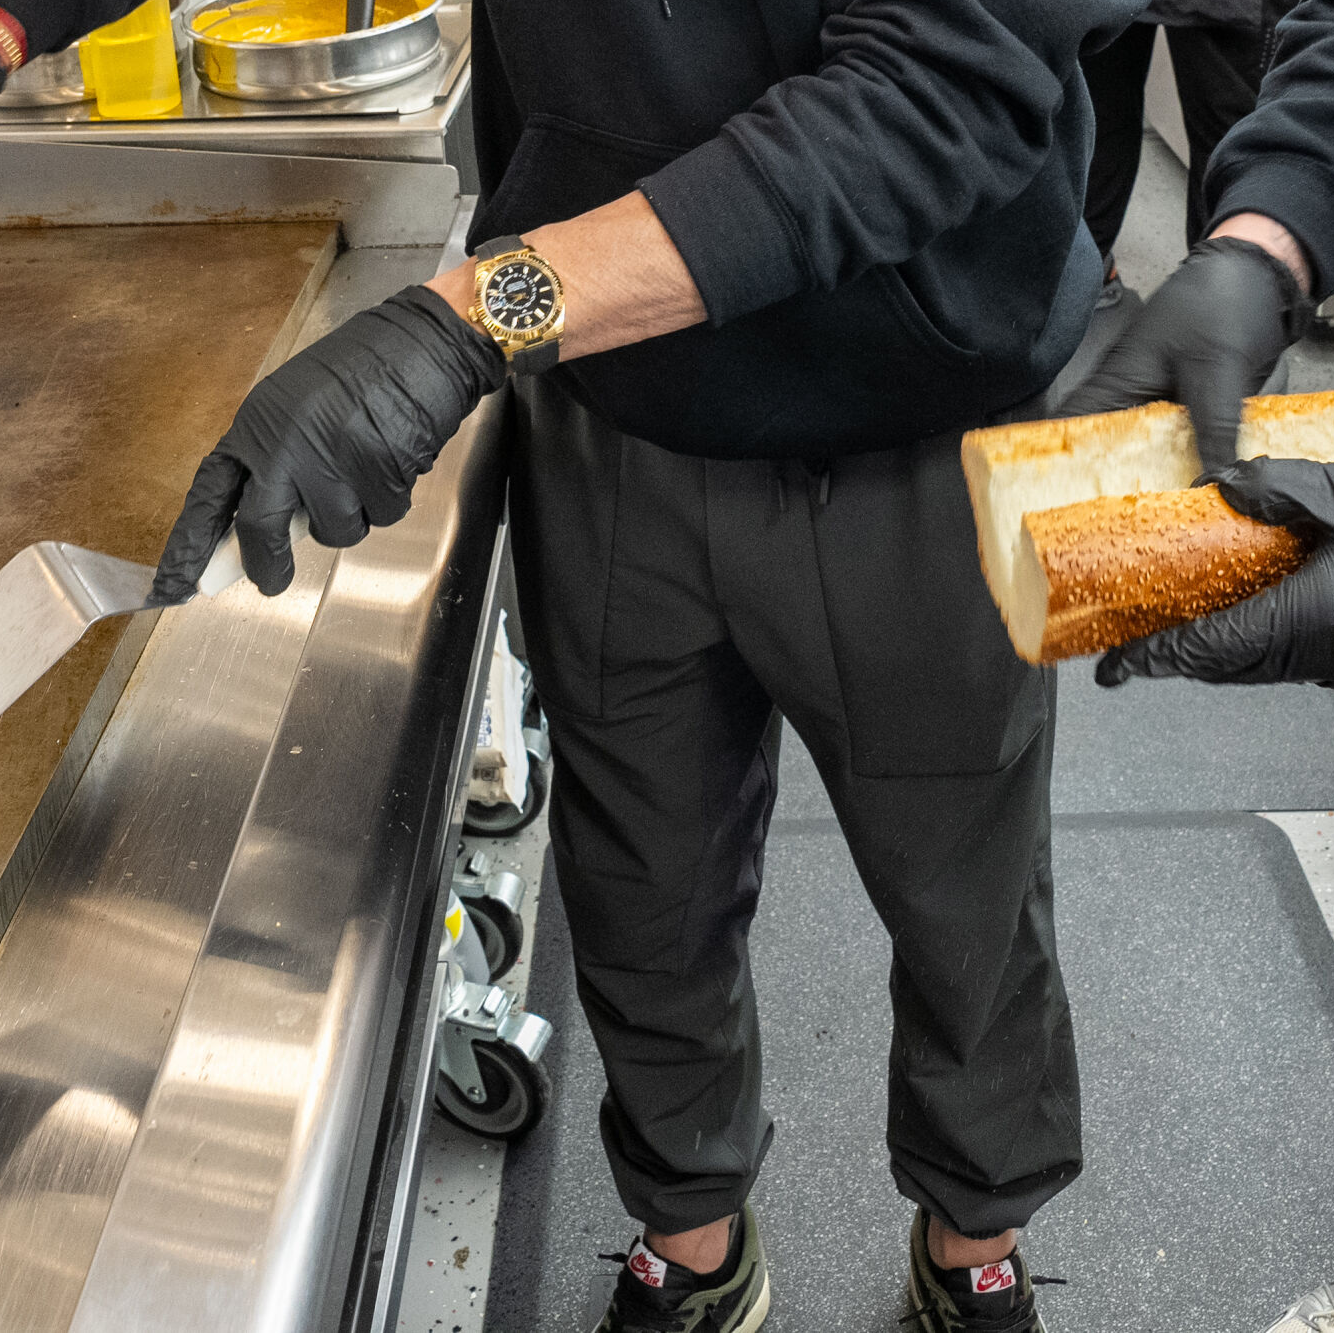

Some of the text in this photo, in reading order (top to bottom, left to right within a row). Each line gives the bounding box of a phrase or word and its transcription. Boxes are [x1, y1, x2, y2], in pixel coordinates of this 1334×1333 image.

[632, 1252, 654, 1272] NIKE
[642, 1273, 661, 1286] AIR
[981, 1263, 1002, 1282] NIKE
[999, 1274, 1013, 1288] AIR
